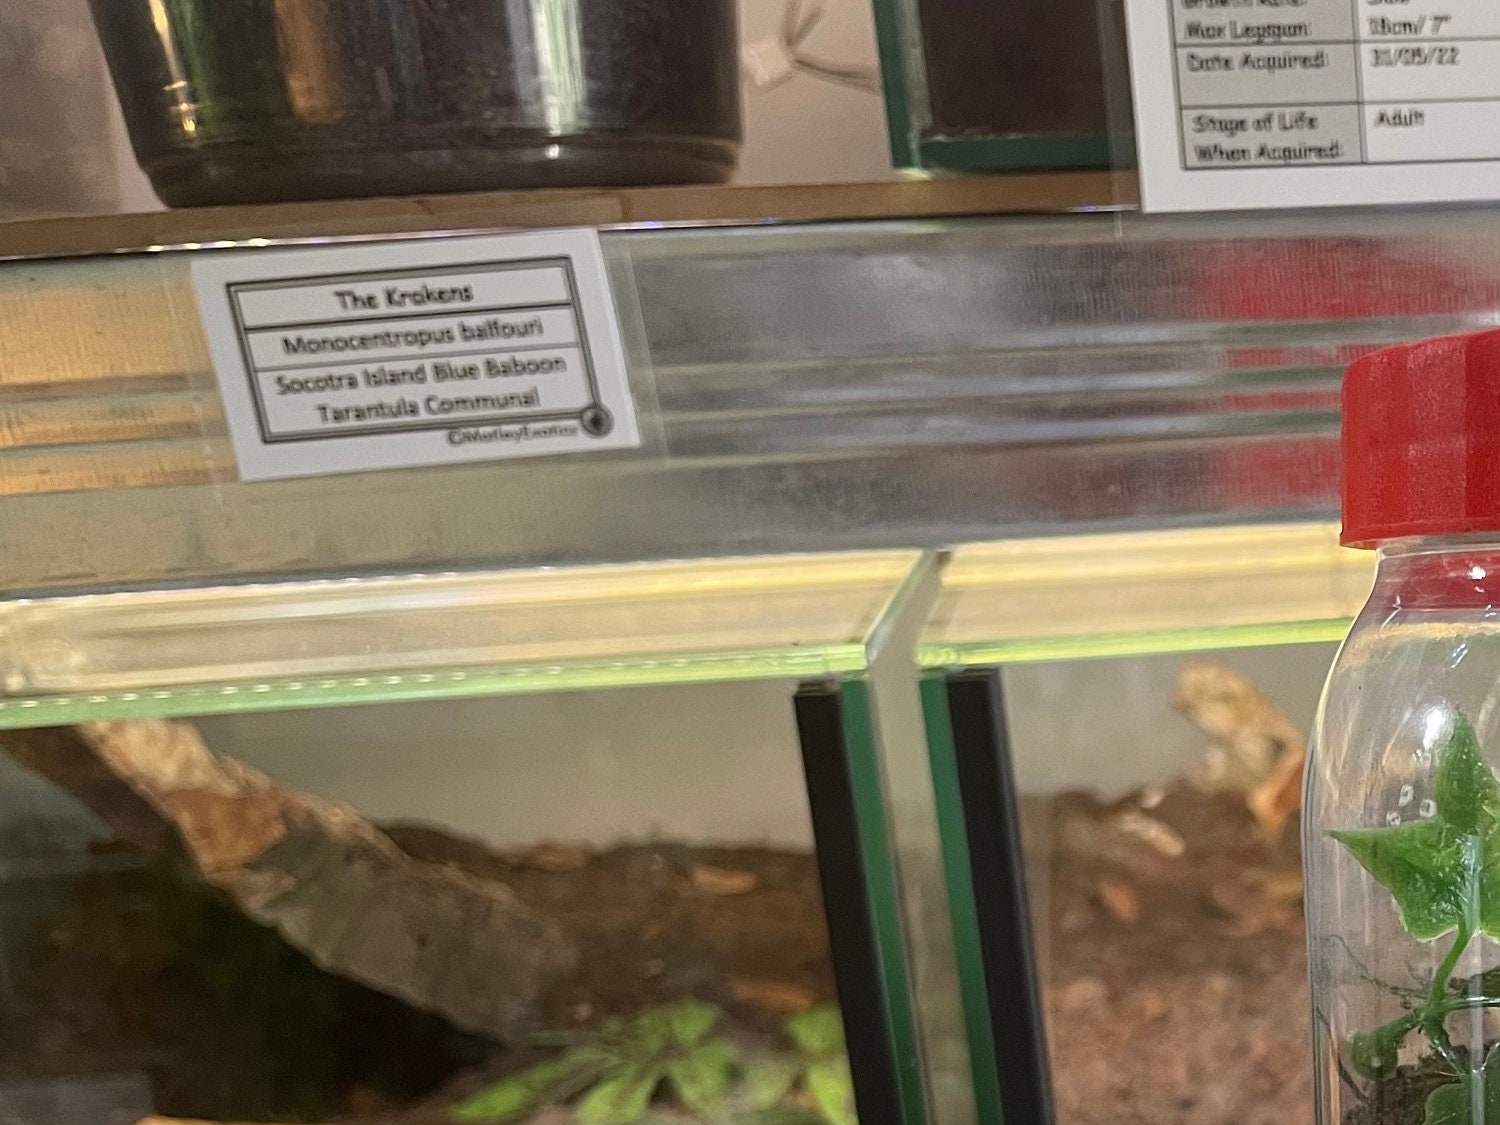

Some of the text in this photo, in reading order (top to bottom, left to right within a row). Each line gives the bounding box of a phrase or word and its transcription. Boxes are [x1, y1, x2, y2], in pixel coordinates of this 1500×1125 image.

[1253, 112, 1273, 131] of
[336, 284, 473, 310] The Krakens
[282, 315, 544, 356] Monocentropus balfouri
[276, 354, 567, 396] Socotra Island Blue Baboon
[318, 387, 541, 425] Tarantula Communal
